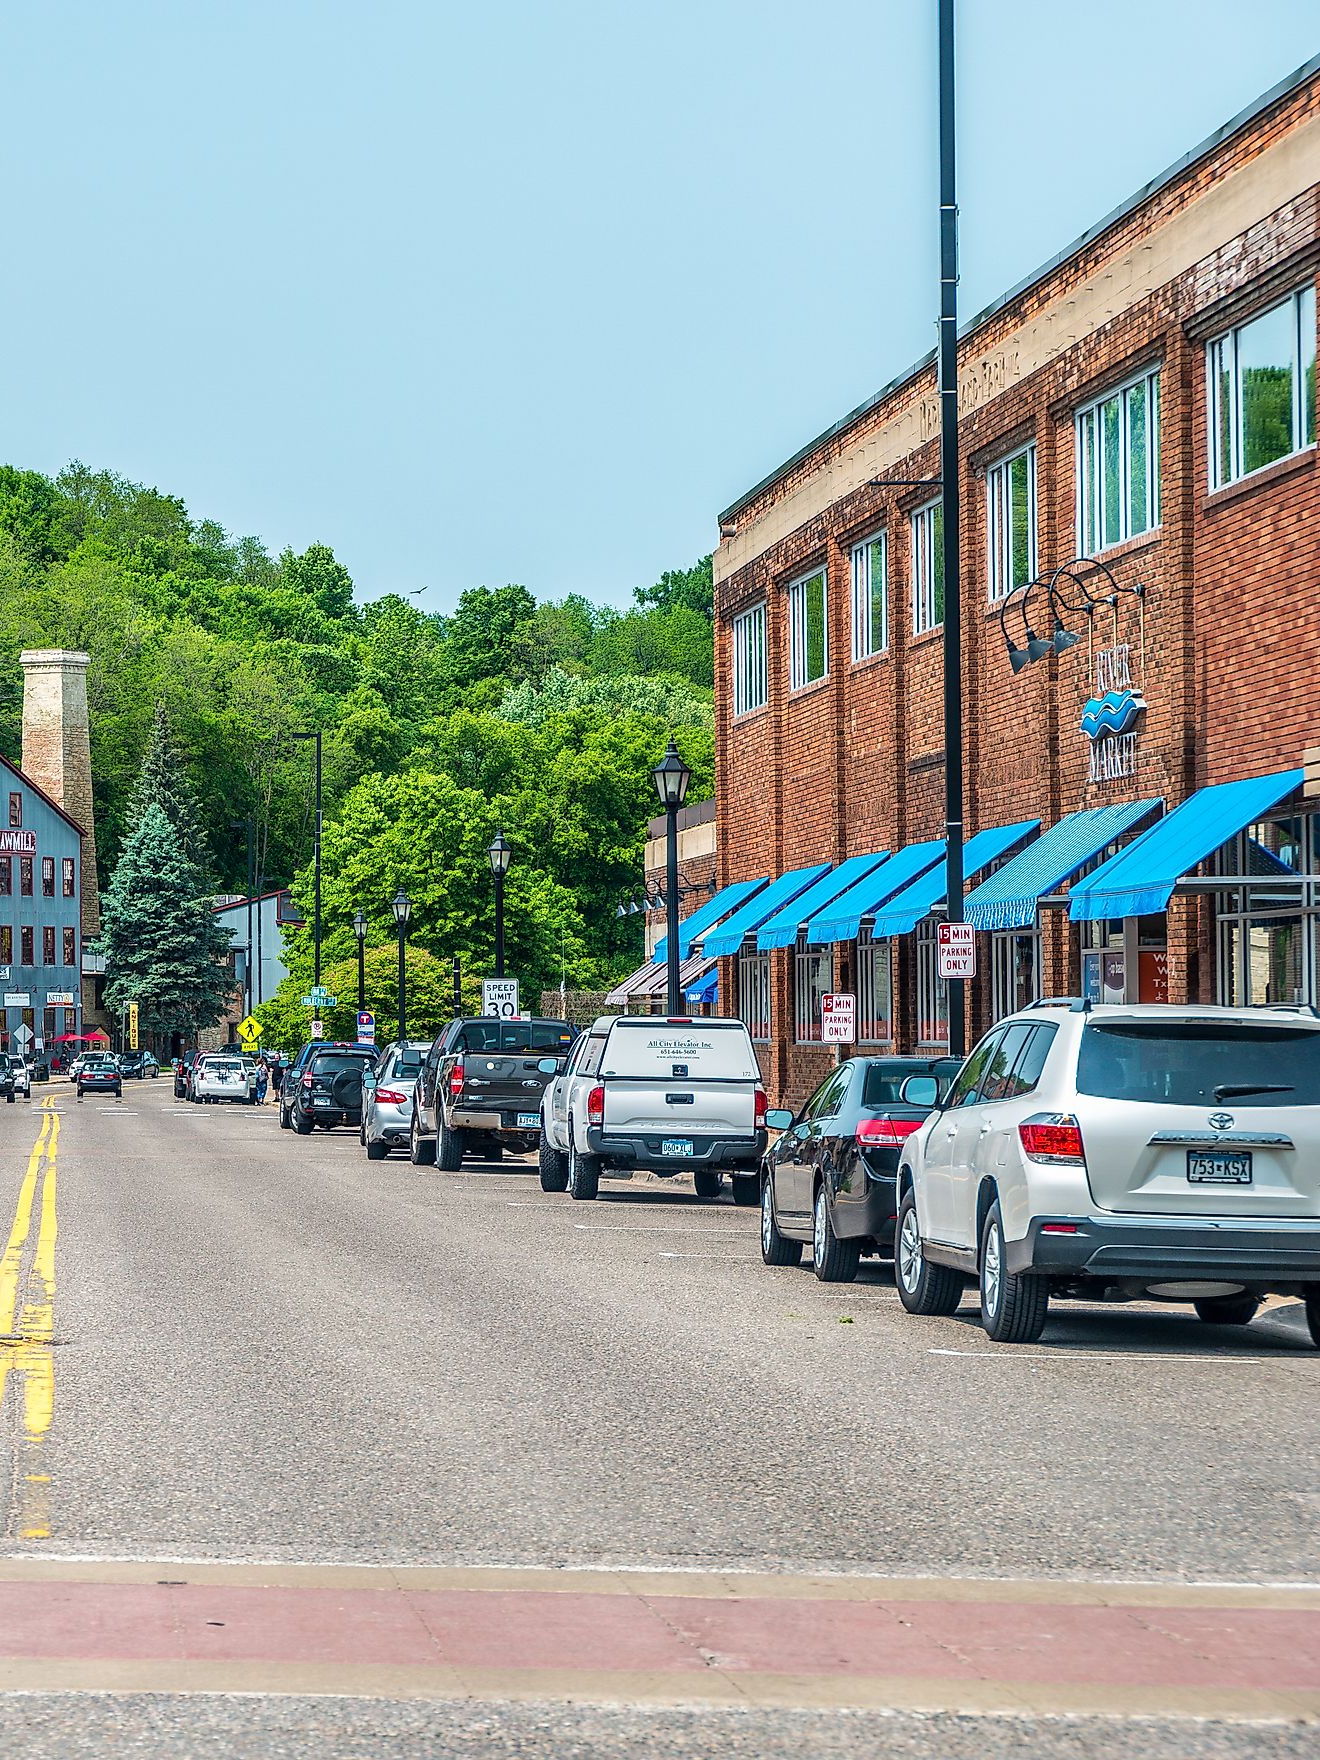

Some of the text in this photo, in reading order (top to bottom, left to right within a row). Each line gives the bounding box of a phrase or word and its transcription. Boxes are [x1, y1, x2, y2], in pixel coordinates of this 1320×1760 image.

[1096, 643, 1131, 692] RIVER
[1088, 732, 1137, 782] MARKET
[940, 928, 970, 940] 15 MIN
[941, 947, 972, 957] PARKING
[946, 959, 968, 970] ONLY
[486, 984, 516, 992] SPEED
[489, 992, 512, 1000] LIMIT
[487, 1001, 515, 1016] 30
[823, 998, 851, 1009] 15 MIN
[824, 1015, 852, 1024] PARKING
[828, 1026, 848, 1036] ONLY
[659, 1040, 672, 1048] City
[673, 1040, 699, 1048] Elevator
[637, 1121, 722, 1129] TACOMA
[1191, 1159, 1248, 1176] 753 KSX
